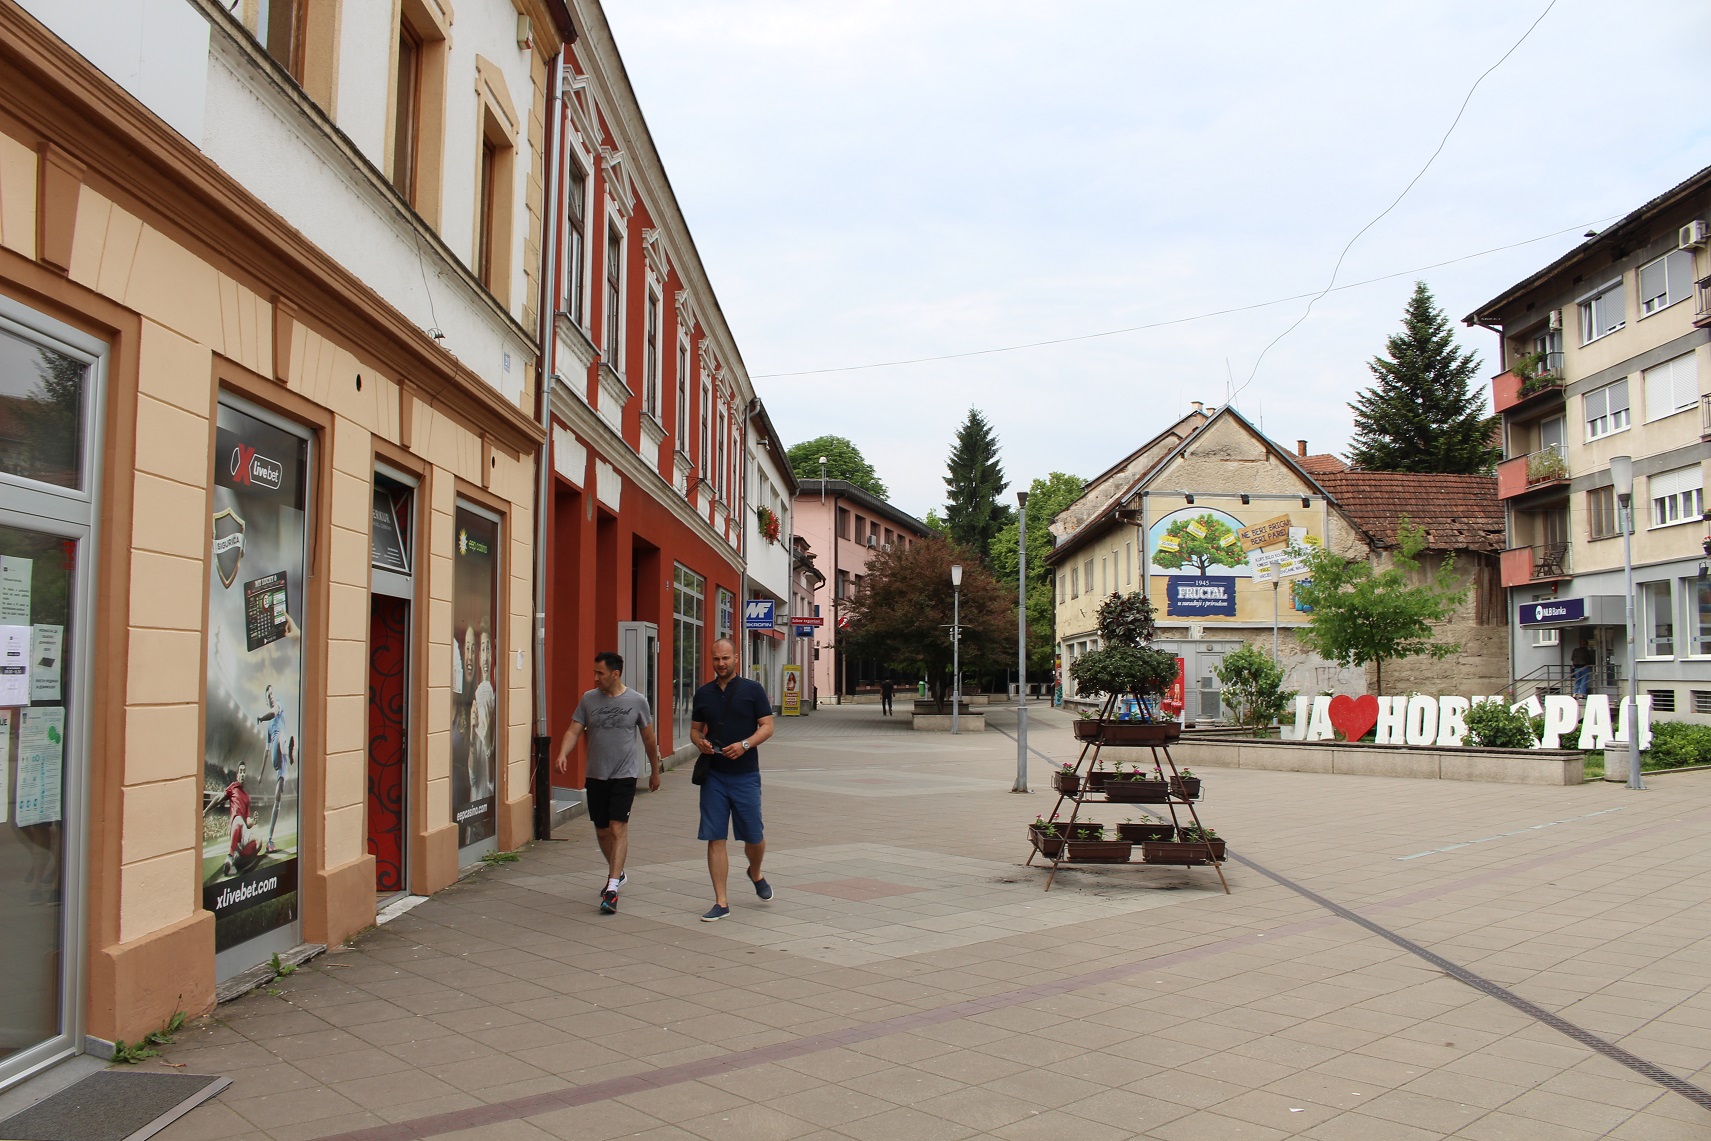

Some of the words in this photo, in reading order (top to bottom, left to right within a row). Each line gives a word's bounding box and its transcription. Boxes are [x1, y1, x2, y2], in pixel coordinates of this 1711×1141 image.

[373, 508, 391, 524] ERKUR
[1241, 531, 1250, 540] NE
[1252, 526, 1268, 537] BERI
[1251, 534, 1267, 545] BERI
[1177, 586, 1228, 600] FRUCTAL
[1552, 606, 1567, 616] Banka
[1374, 695, 1505, 747] НОВ
[215, 876, 278, 910] xlivebet.com
